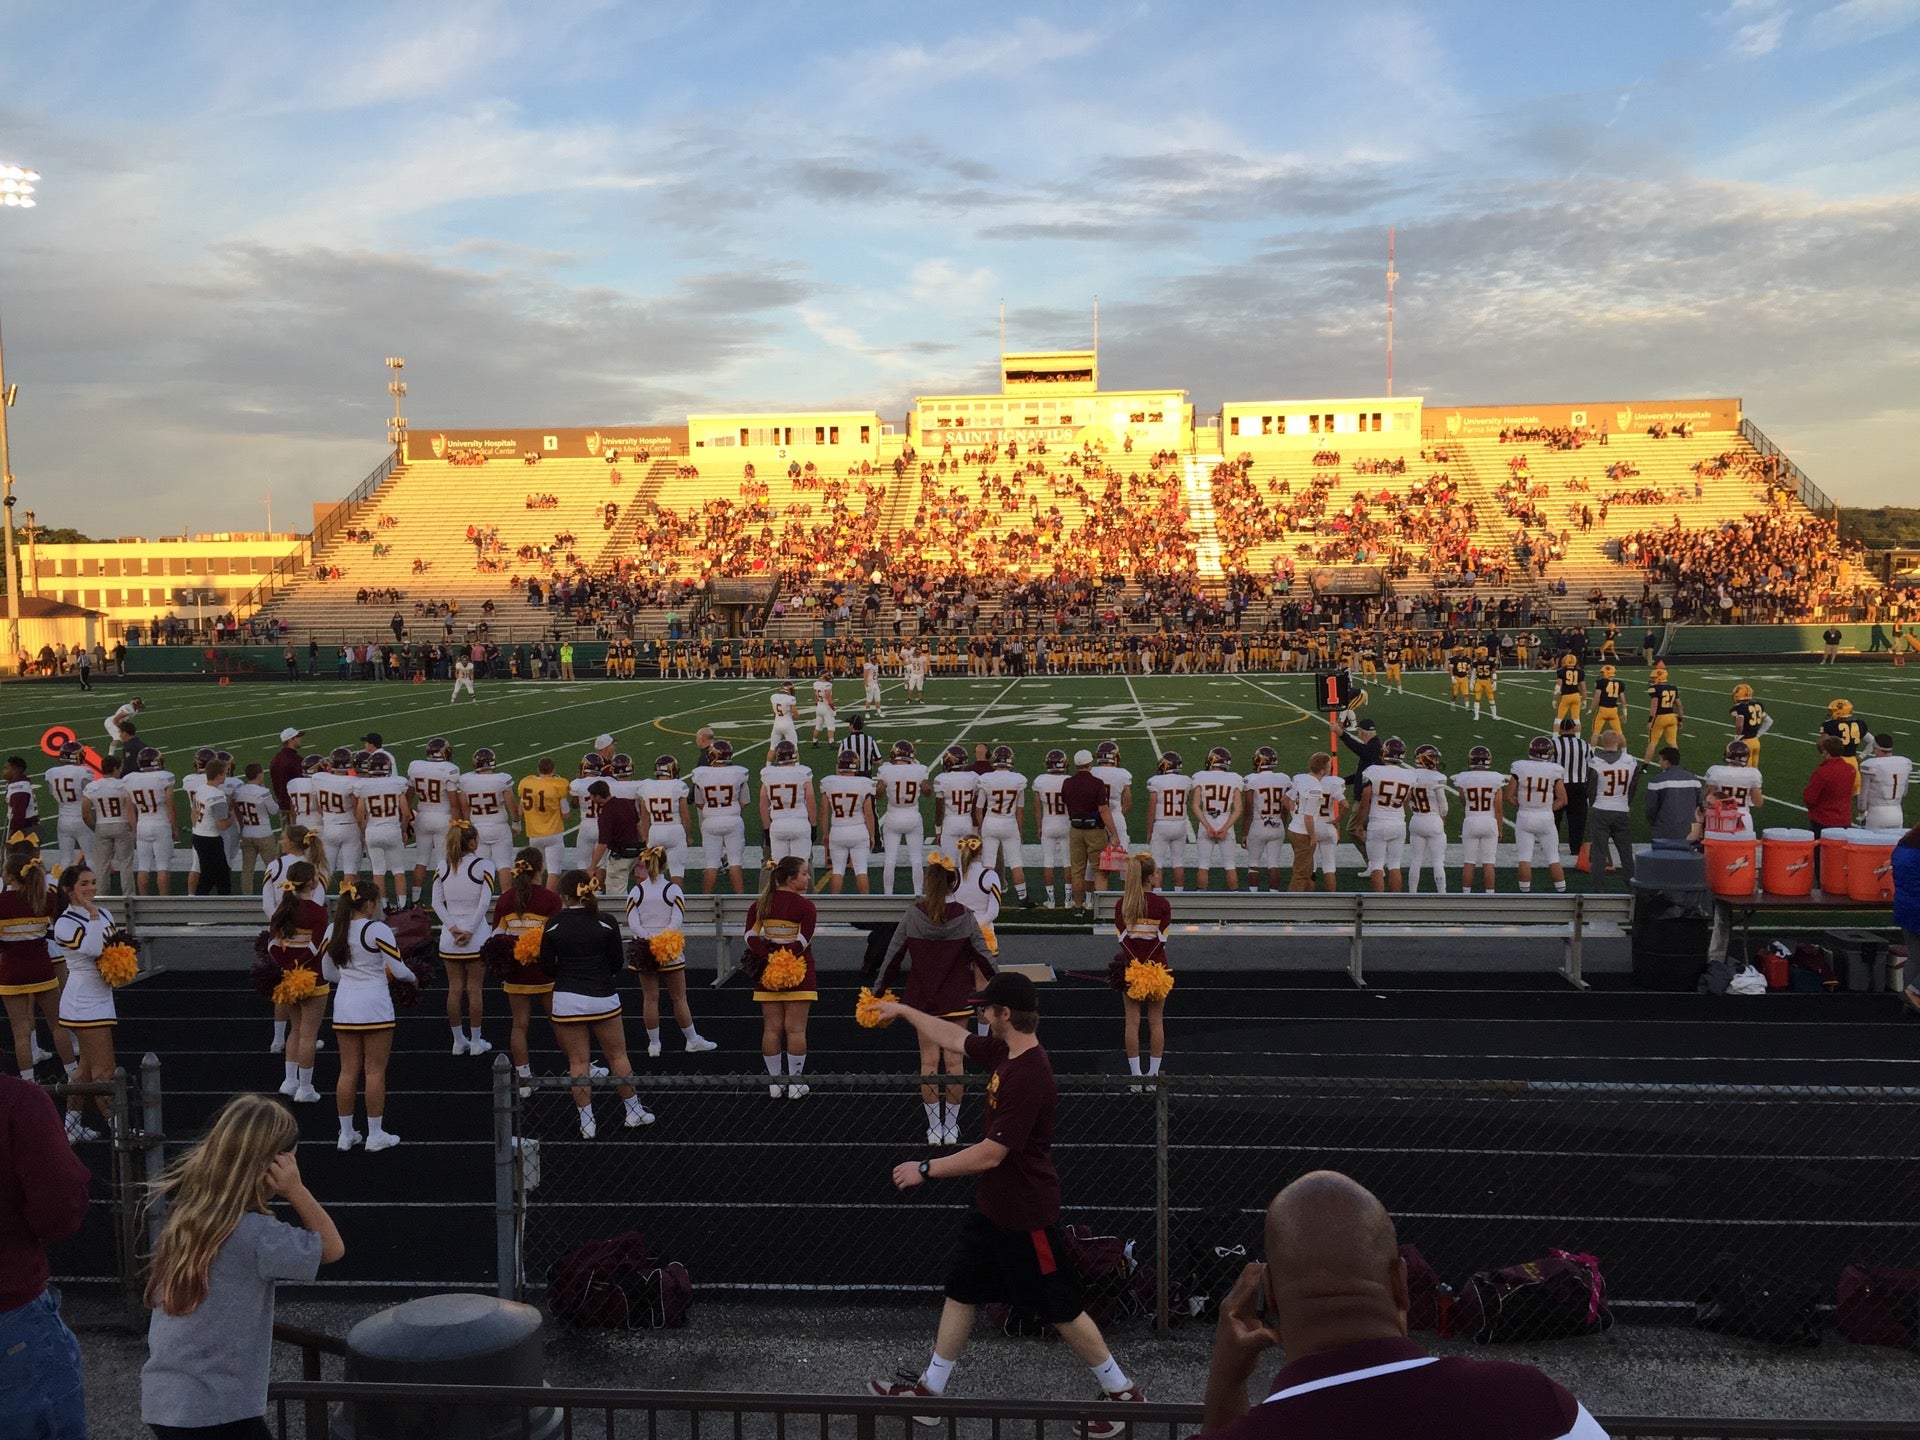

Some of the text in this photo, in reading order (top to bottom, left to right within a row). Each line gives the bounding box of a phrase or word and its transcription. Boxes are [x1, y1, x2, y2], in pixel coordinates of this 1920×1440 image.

[1463, 415, 1539, 426] University Hospitals
[1634, 411, 1711, 421] University Hospitals
[447, 439, 517, 448] University Hospitals
[602, 437, 638, 446] University
[639, 436, 672, 445] Hospitals
[945, 428, 1073, 443] SAINT IGNATIUS
[1476, 664, 1491, 676] 55
[1565, 669, 1579, 686] 91
[1325, 675, 1339, 705] 1
[1605, 680, 1620, 698] 41
[1661, 689, 1677, 709] 27
[776, 703, 784, 717] 5
[1747, 703, 1763, 727] 33
[1837, 721, 1861, 746] 34
[54, 777, 78, 803] 15
[414, 777, 442, 804] 58
[894, 780, 918, 805] 19
[1377, 780, 1410, 809] 59
[1525, 776, 1550, 803] 14
[1603, 769, 1630, 797] 34
[97, 796, 122, 818] 18
[132, 788, 158, 814] 91
[367, 793, 397, 818] 60
[467, 791, 499, 816] 52
[522, 787, 546, 812] 51
[704, 785, 735, 809] 63
[769, 783, 798, 811] 57
[830, 792, 859, 819] 67
[991, 789, 1018, 814] 37
[1162, 788, 1186, 817] 83
[1204, 784, 1231, 813] 24
[1258, 787, 1284, 815] 39
[1466, 787, 1493, 812] 96
[648, 797, 674, 823] 62
